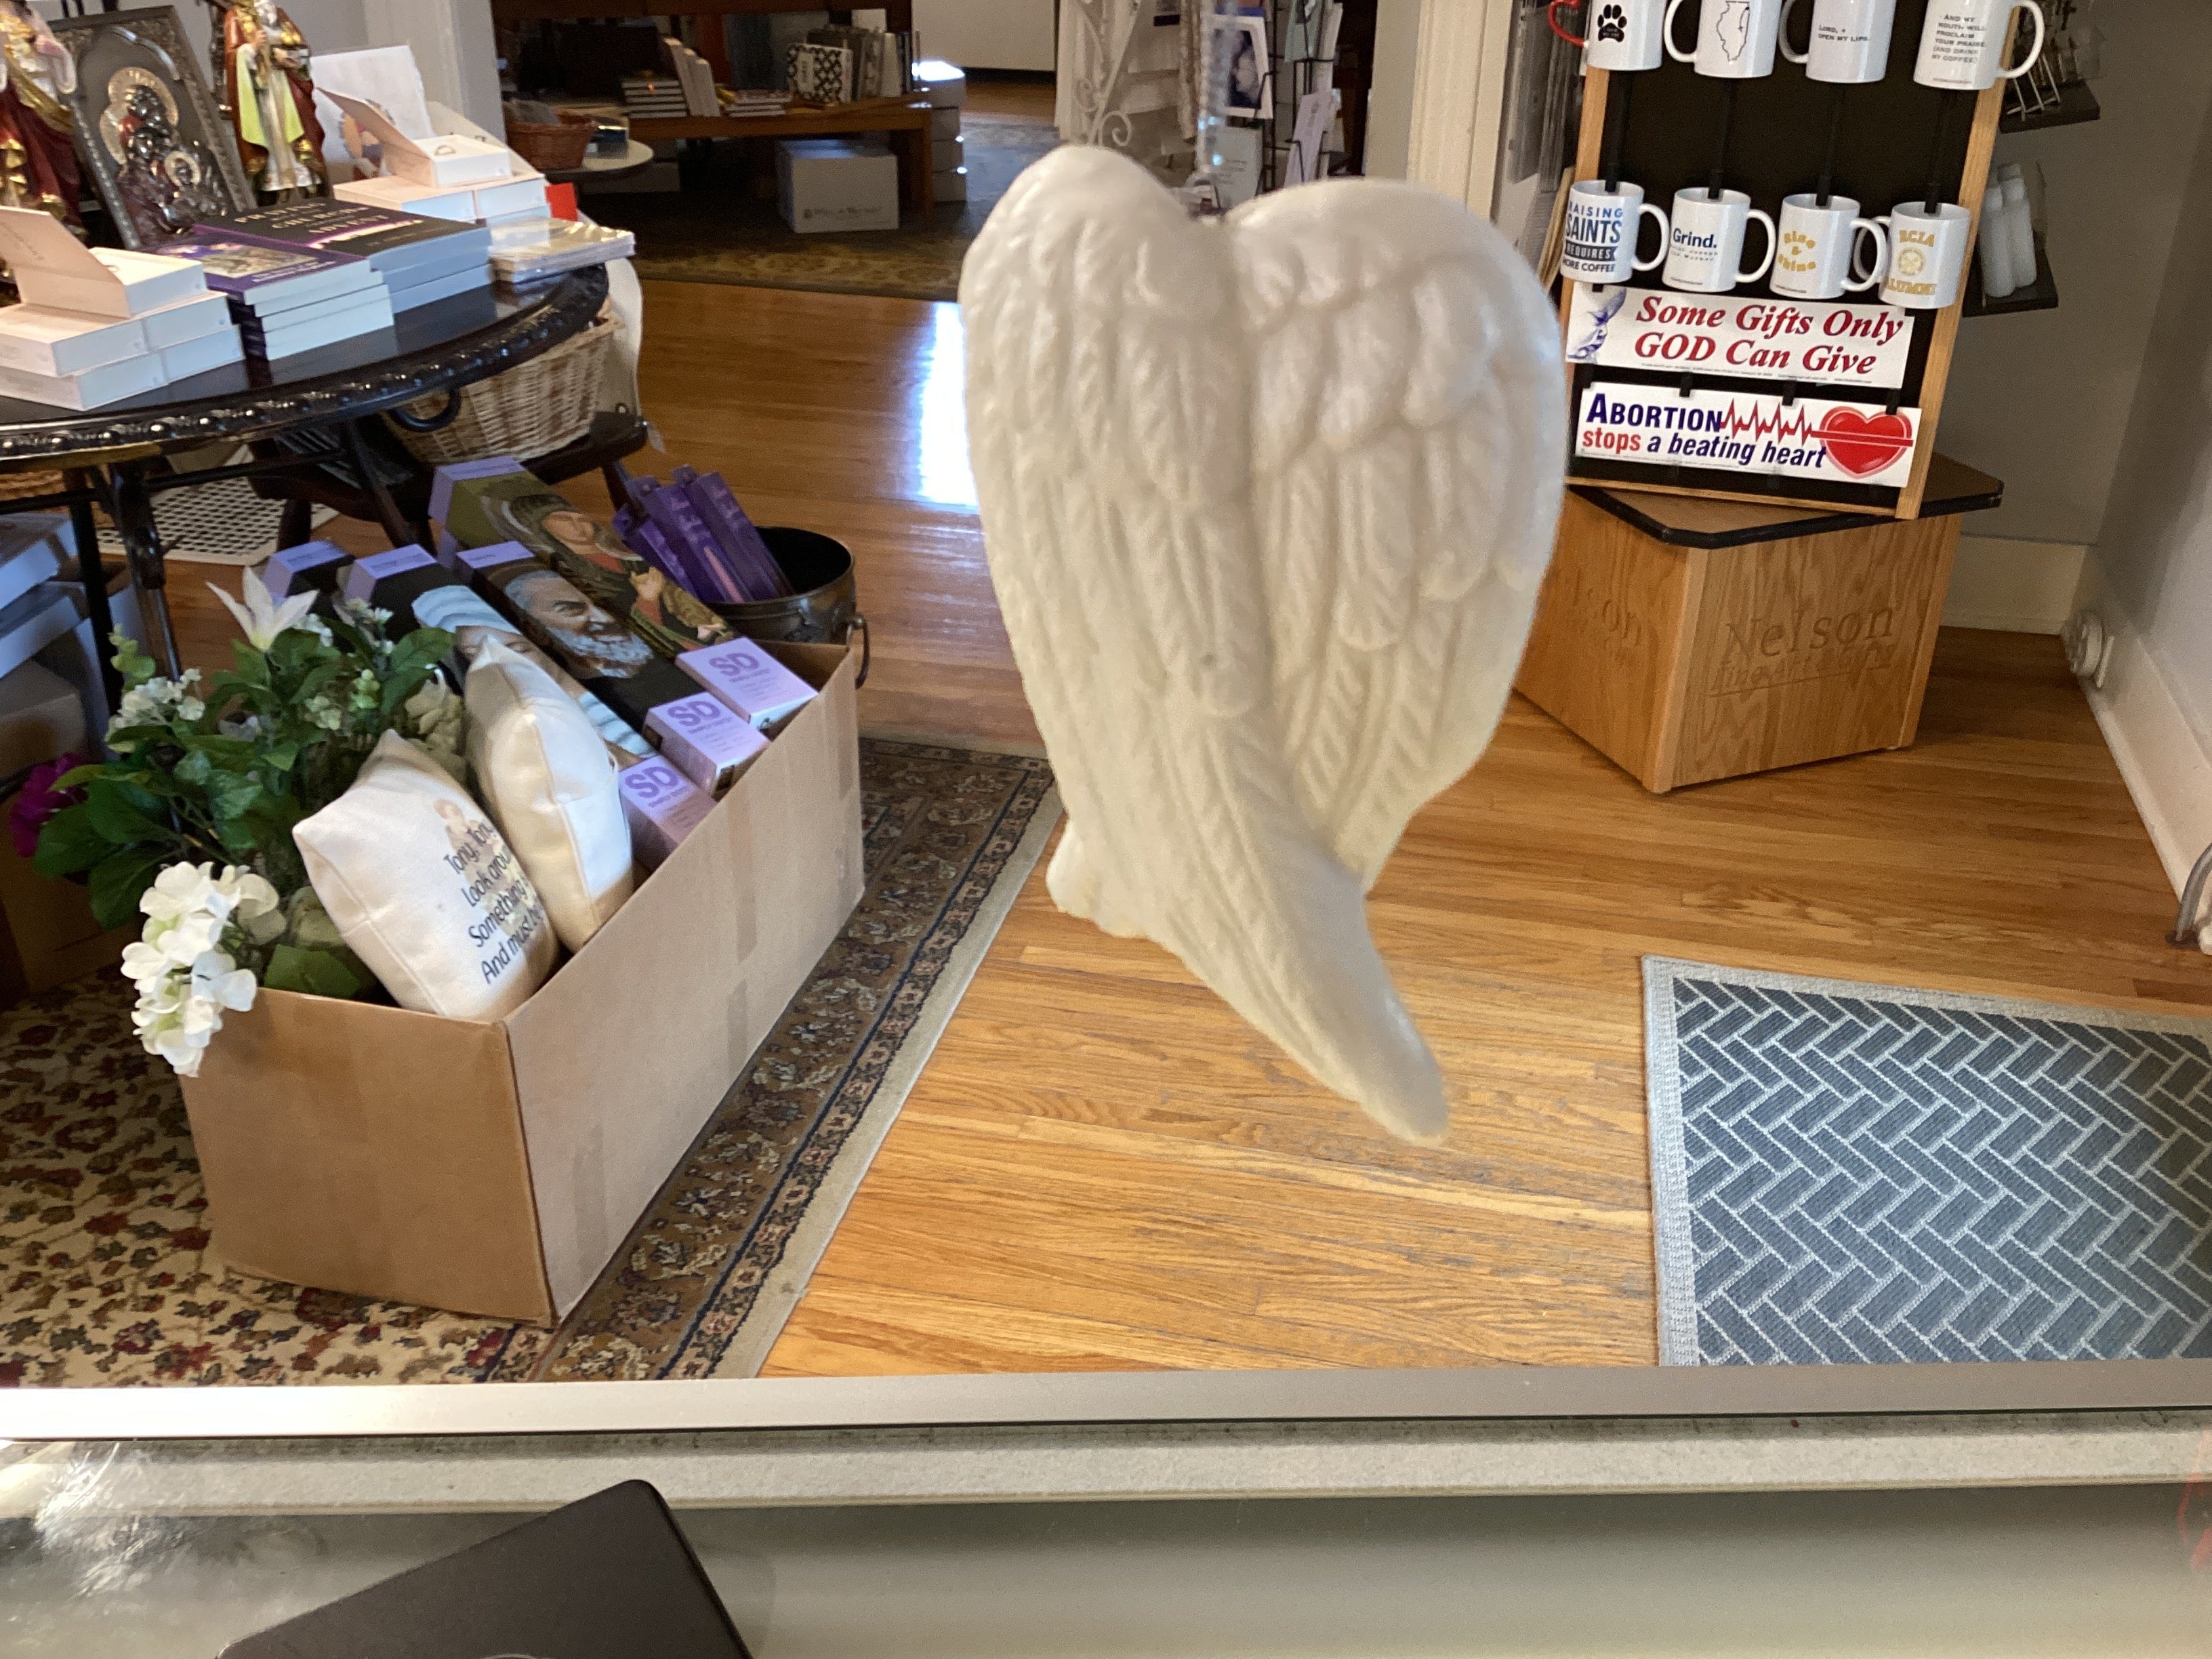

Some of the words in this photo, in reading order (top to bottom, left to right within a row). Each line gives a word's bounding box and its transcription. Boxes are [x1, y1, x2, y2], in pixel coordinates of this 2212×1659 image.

[1936, 30, 1975, 39] PROCLAIM
[1565, 213, 1622, 244] SAINTS
[1673, 228, 1718, 249] Grind.
[1565, 243, 1612, 260] REQUIRES
[1580, 261, 1616, 272] COFFEE
[1635, 296, 1726, 327] Some
[1736, 304, 1814, 340] Gifts
[1823, 310, 1904, 346] Only
[1635, 331, 1717, 361] GOD
[1726, 340, 1791, 369] Can
[1802, 345, 1877, 374] Give
[1586, 393, 1723, 433] ABORTION
[1582, 428, 1642, 454] stops
[1647, 436, 1661, 453] a
[1667, 433, 1756, 466] beating
[1761, 441, 1826, 468] heart
[1721, 606, 1895, 664] Nelson
[709, 652, 760, 676] SD
[667, 701, 721, 726] SD
[625, 766, 678, 798] SD
[461, 870, 494, 907] Look
[481, 941, 511, 984] And
